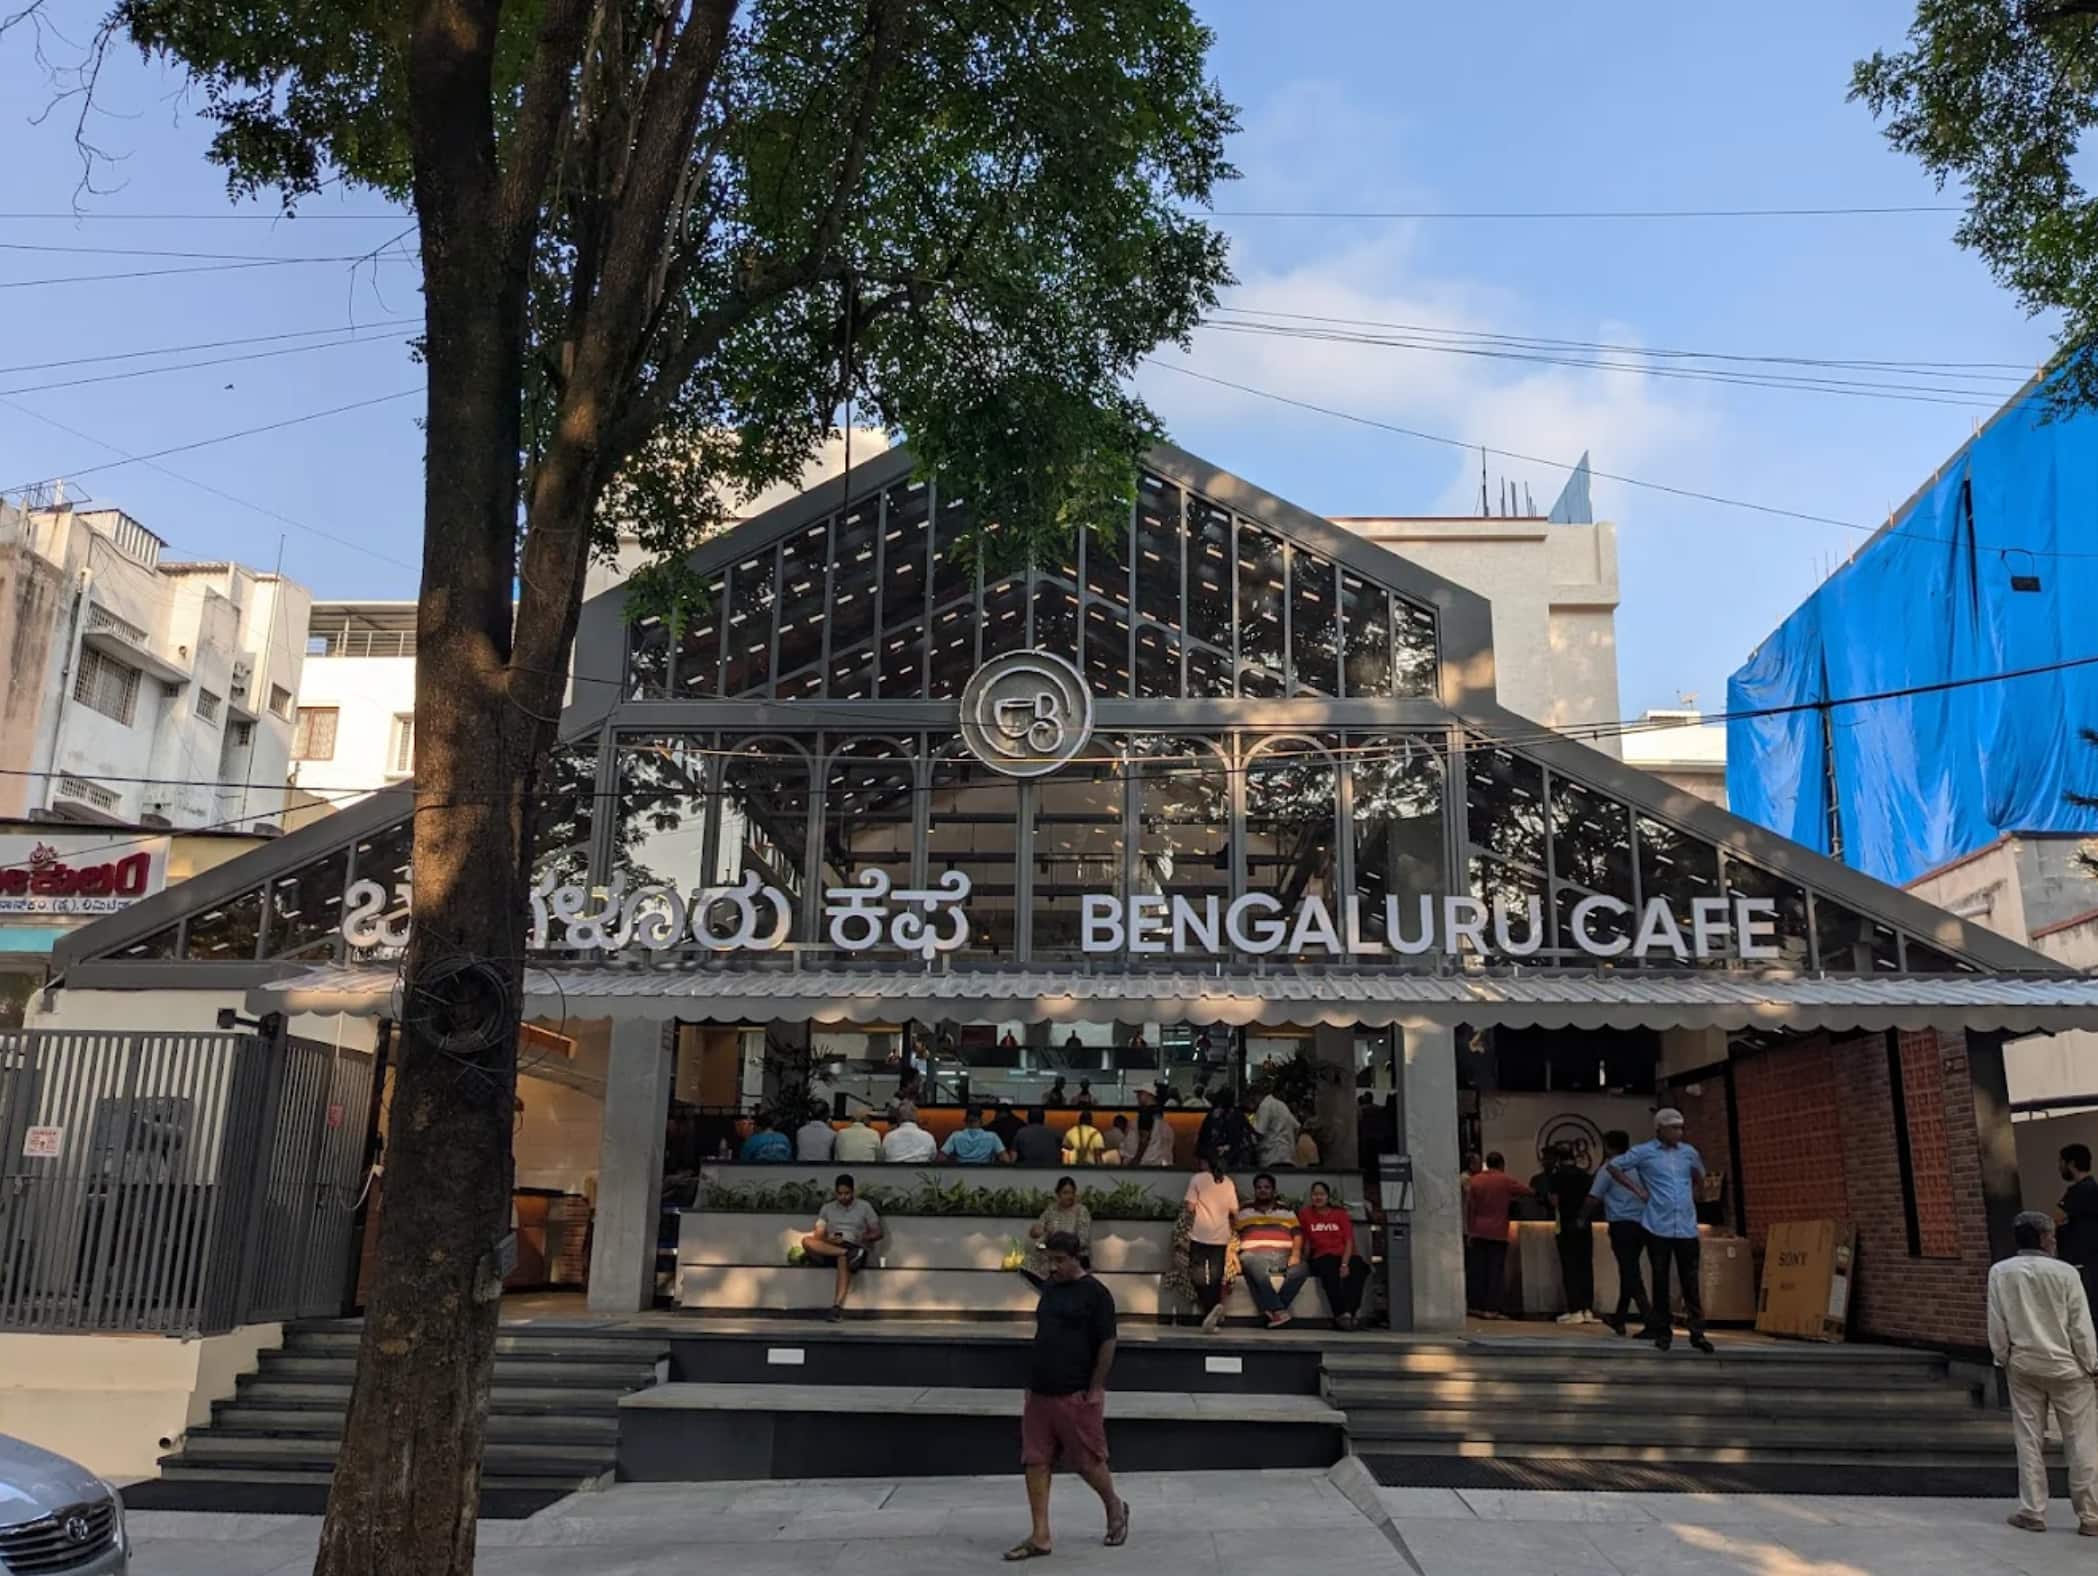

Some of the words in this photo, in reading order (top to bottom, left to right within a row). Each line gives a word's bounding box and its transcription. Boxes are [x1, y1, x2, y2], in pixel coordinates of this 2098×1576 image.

[826, 868, 971, 960] ಕೆಫೆ
[1081, 893, 1543, 956] BENGALURU
[1571, 895, 1779, 958] CAFE
